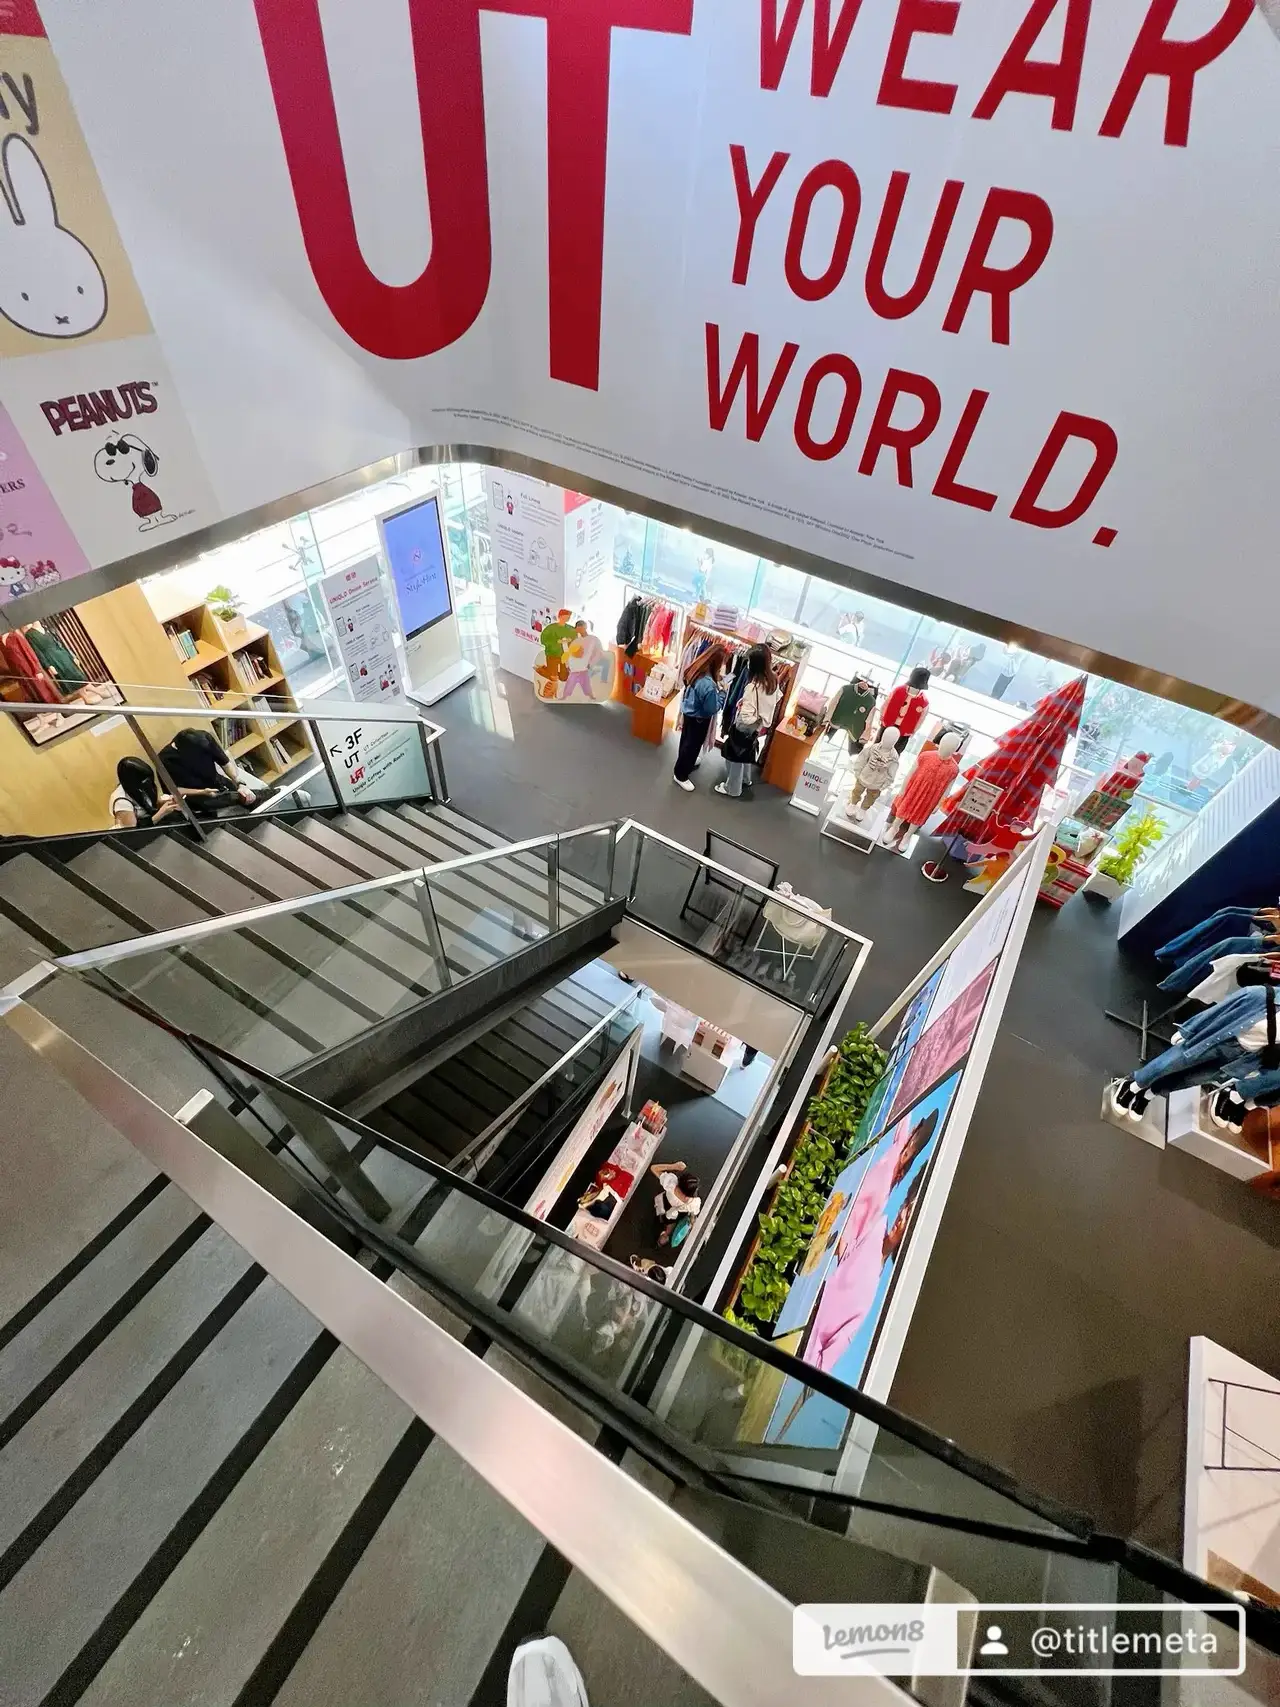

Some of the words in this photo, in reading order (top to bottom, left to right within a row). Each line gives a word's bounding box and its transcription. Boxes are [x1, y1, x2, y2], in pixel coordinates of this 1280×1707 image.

[756, 0, 1256, 148] WEAR
[255, 0, 693, 391] UT
[728, 144, 1055, 346] YOUR
[39, 381, 158, 436] PEANUTS
[705, 322, 1119, 548] WORLD.
[344, 750, 360, 769] UT
[345, 727, 362, 750] 3F
[802, 771, 828, 784] UNIQLO
[805, 781, 820, 791] KIDS
